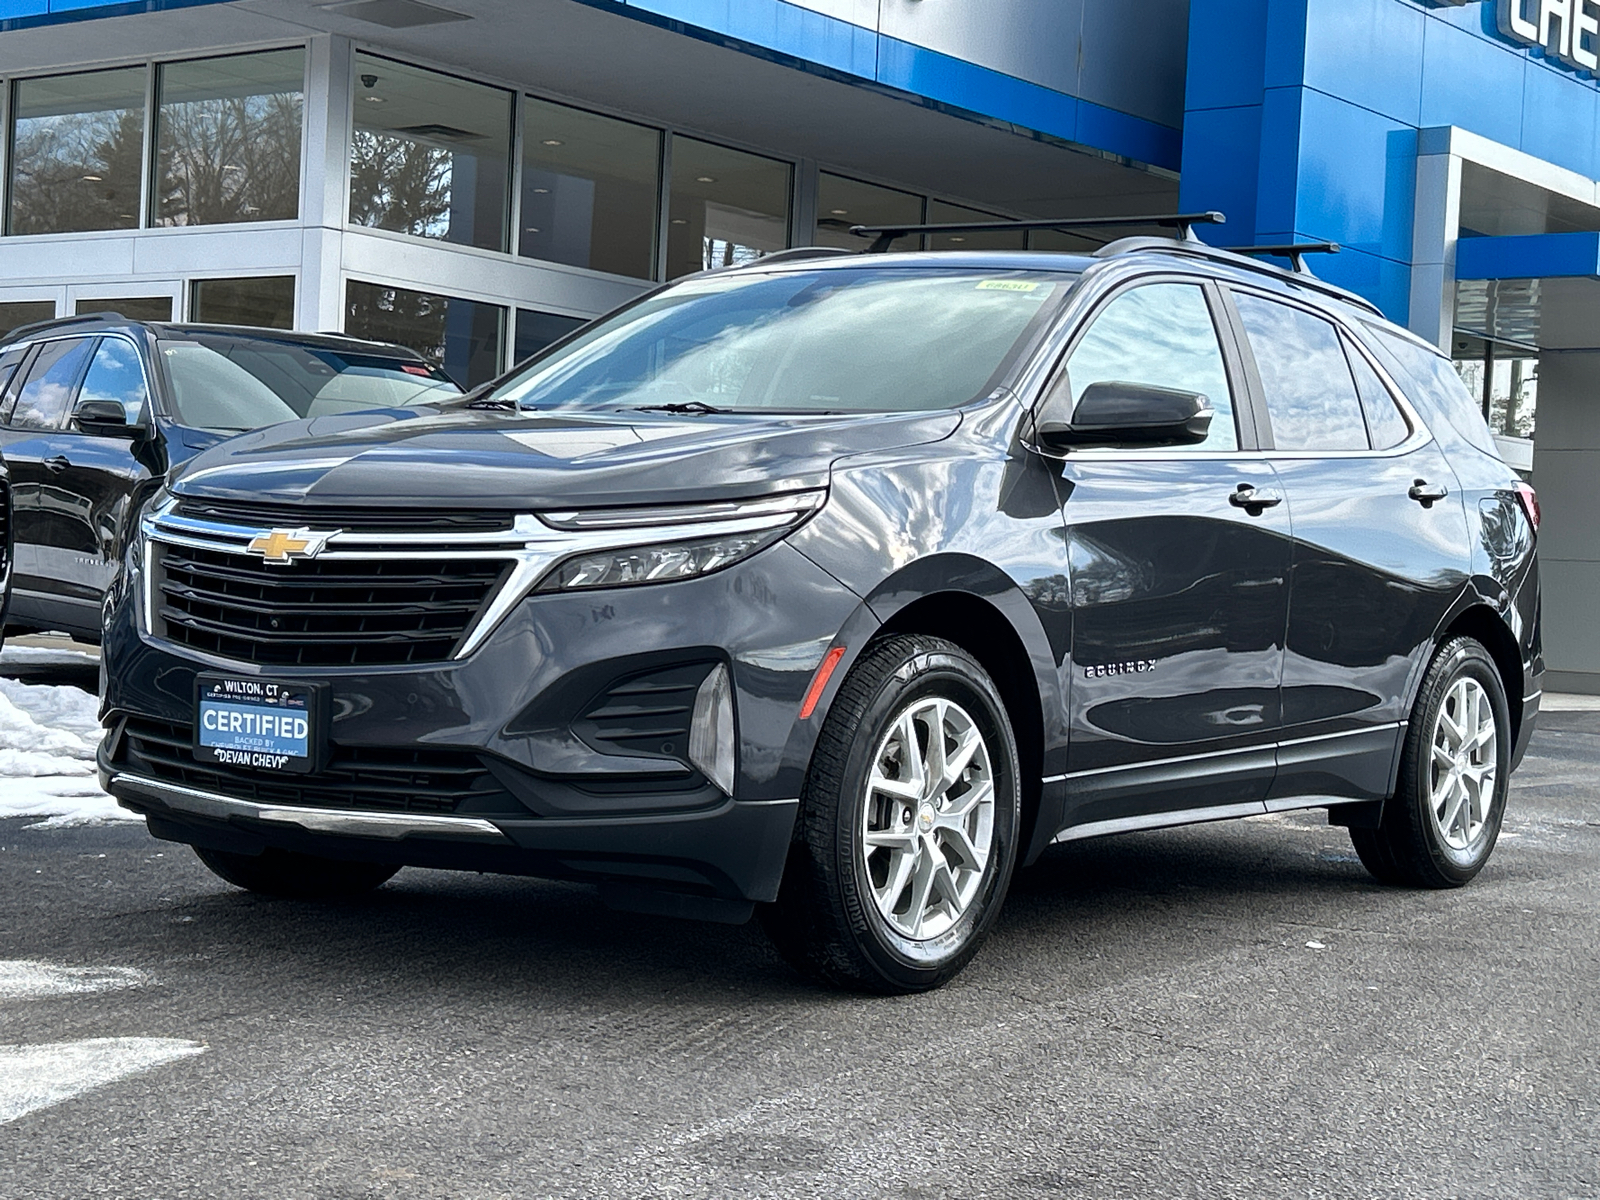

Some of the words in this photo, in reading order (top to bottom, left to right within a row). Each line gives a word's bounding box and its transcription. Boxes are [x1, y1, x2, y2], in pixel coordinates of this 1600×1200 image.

[1085, 659, 1156, 678] EQUINOX
[224, 680, 263, 695] WILTON,
[266, 684, 278, 696] CT
[203, 709, 309, 739] CERTIFIED
[234, 736, 263, 747] BACKED
[264, 739, 275, 748] BY
[219, 750, 250, 765] DEVAN
[252, 753, 283, 768] CHEVY
